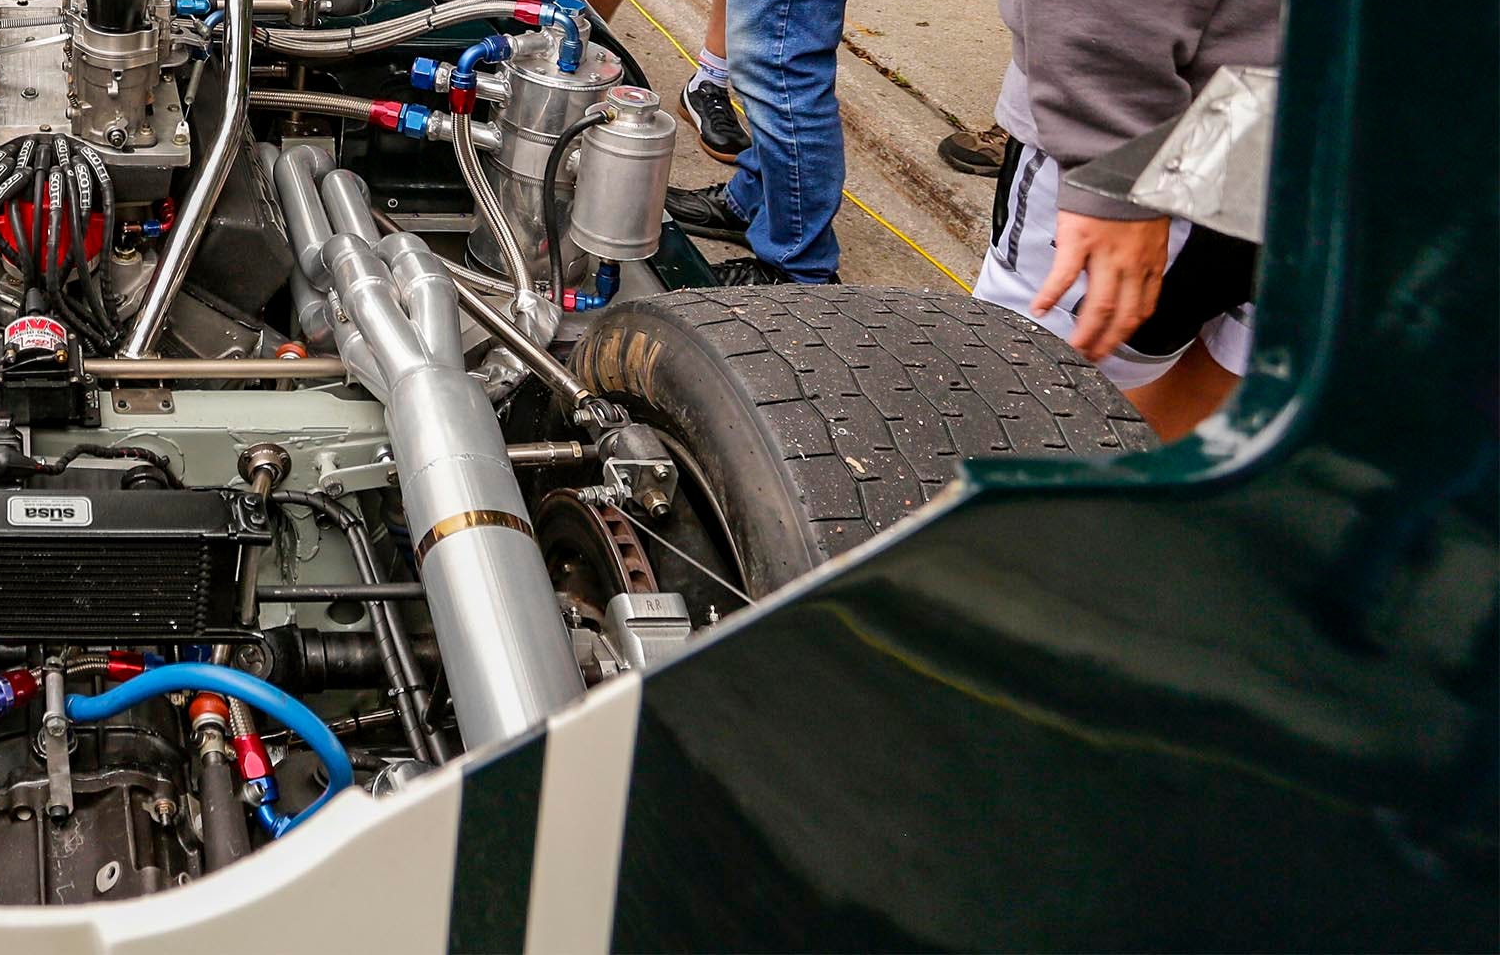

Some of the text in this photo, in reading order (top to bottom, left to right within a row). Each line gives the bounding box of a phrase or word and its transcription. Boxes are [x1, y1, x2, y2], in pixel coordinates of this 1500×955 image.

[82, 147, 110, 182] SCOTT
[49, 173, 62, 208] SCOTT
[75, 164, 92, 208] SCOTT
[8, 318, 65, 338] HVC
